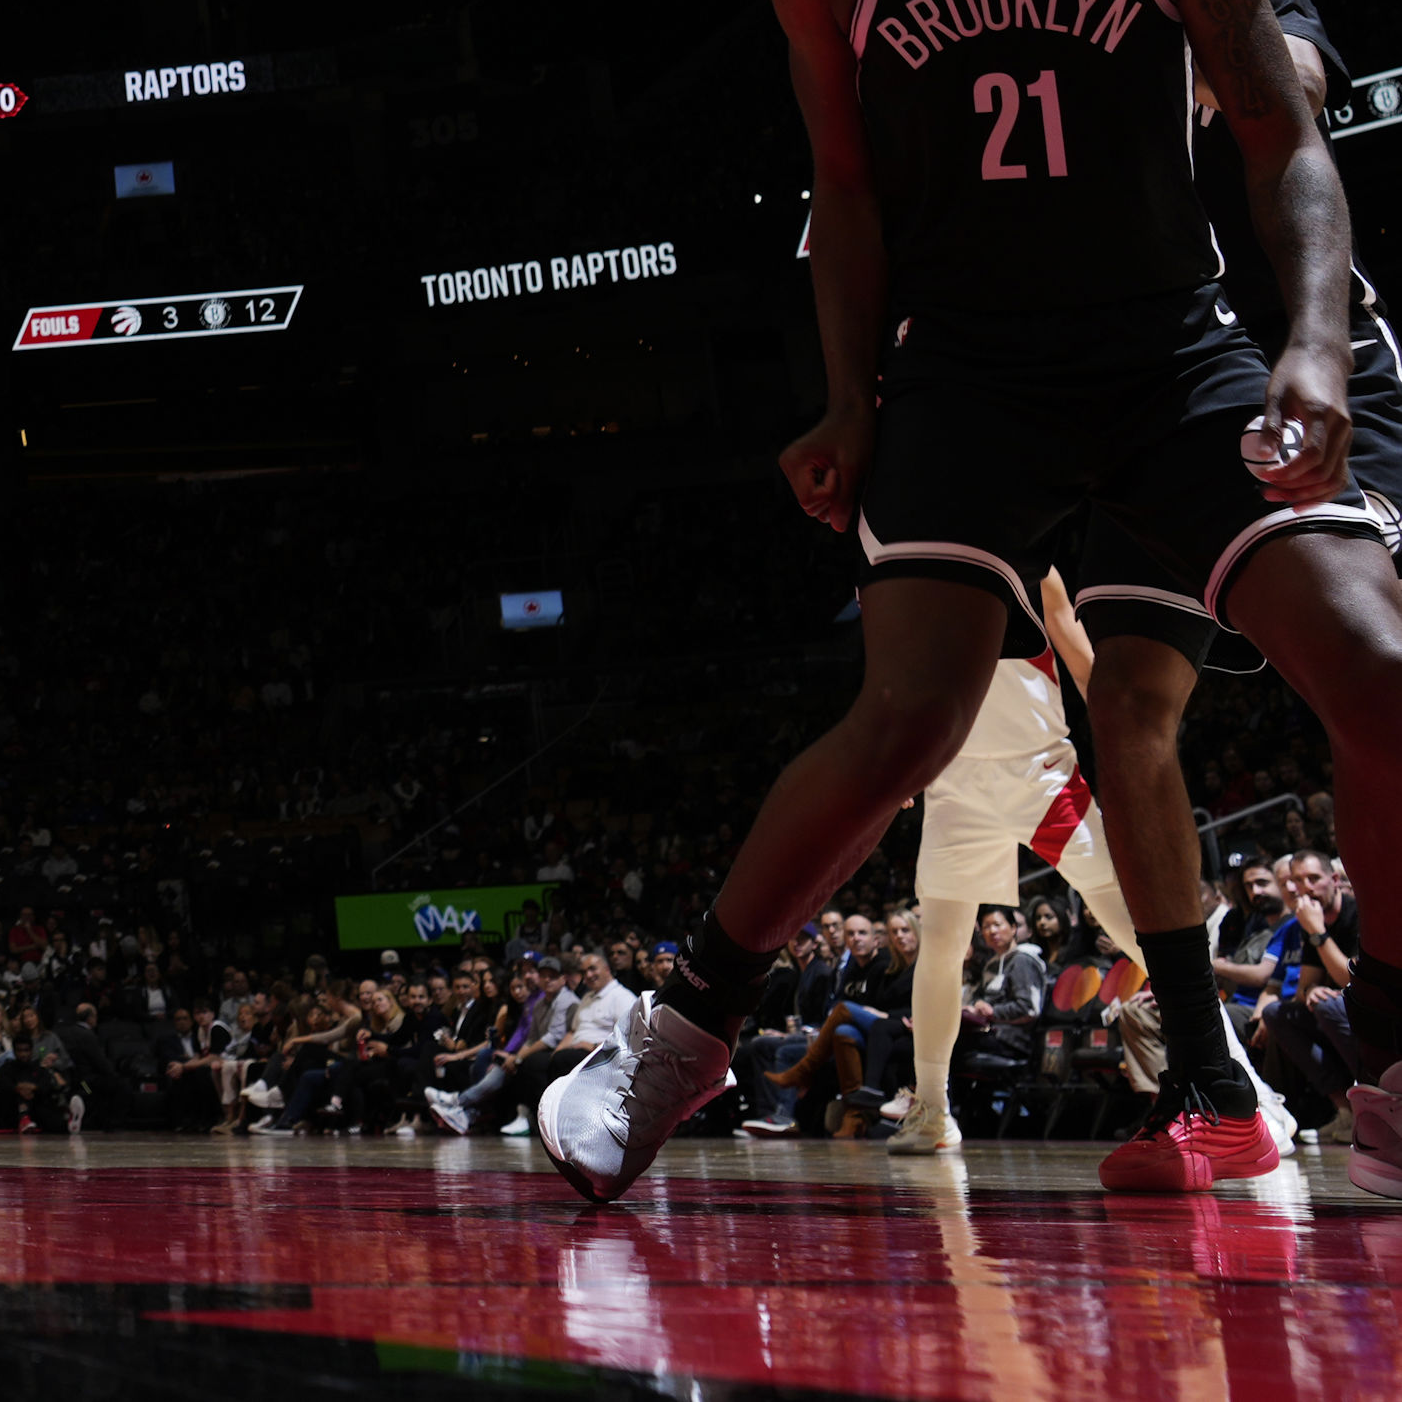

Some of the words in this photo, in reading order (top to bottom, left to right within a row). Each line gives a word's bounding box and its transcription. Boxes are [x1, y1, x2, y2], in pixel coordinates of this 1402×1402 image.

[125, 61, 246, 101] RAPTORS
[973, 70, 1068, 180] 21
[421, 260, 544, 308] TORONTO
[551, 242, 677, 292] RAPTORS
[31, 315, 79, 338] FOULS
[162, 306, 178, 330] 3
[244, 298, 276, 323] 12
[414, 904, 478, 942] MAX
